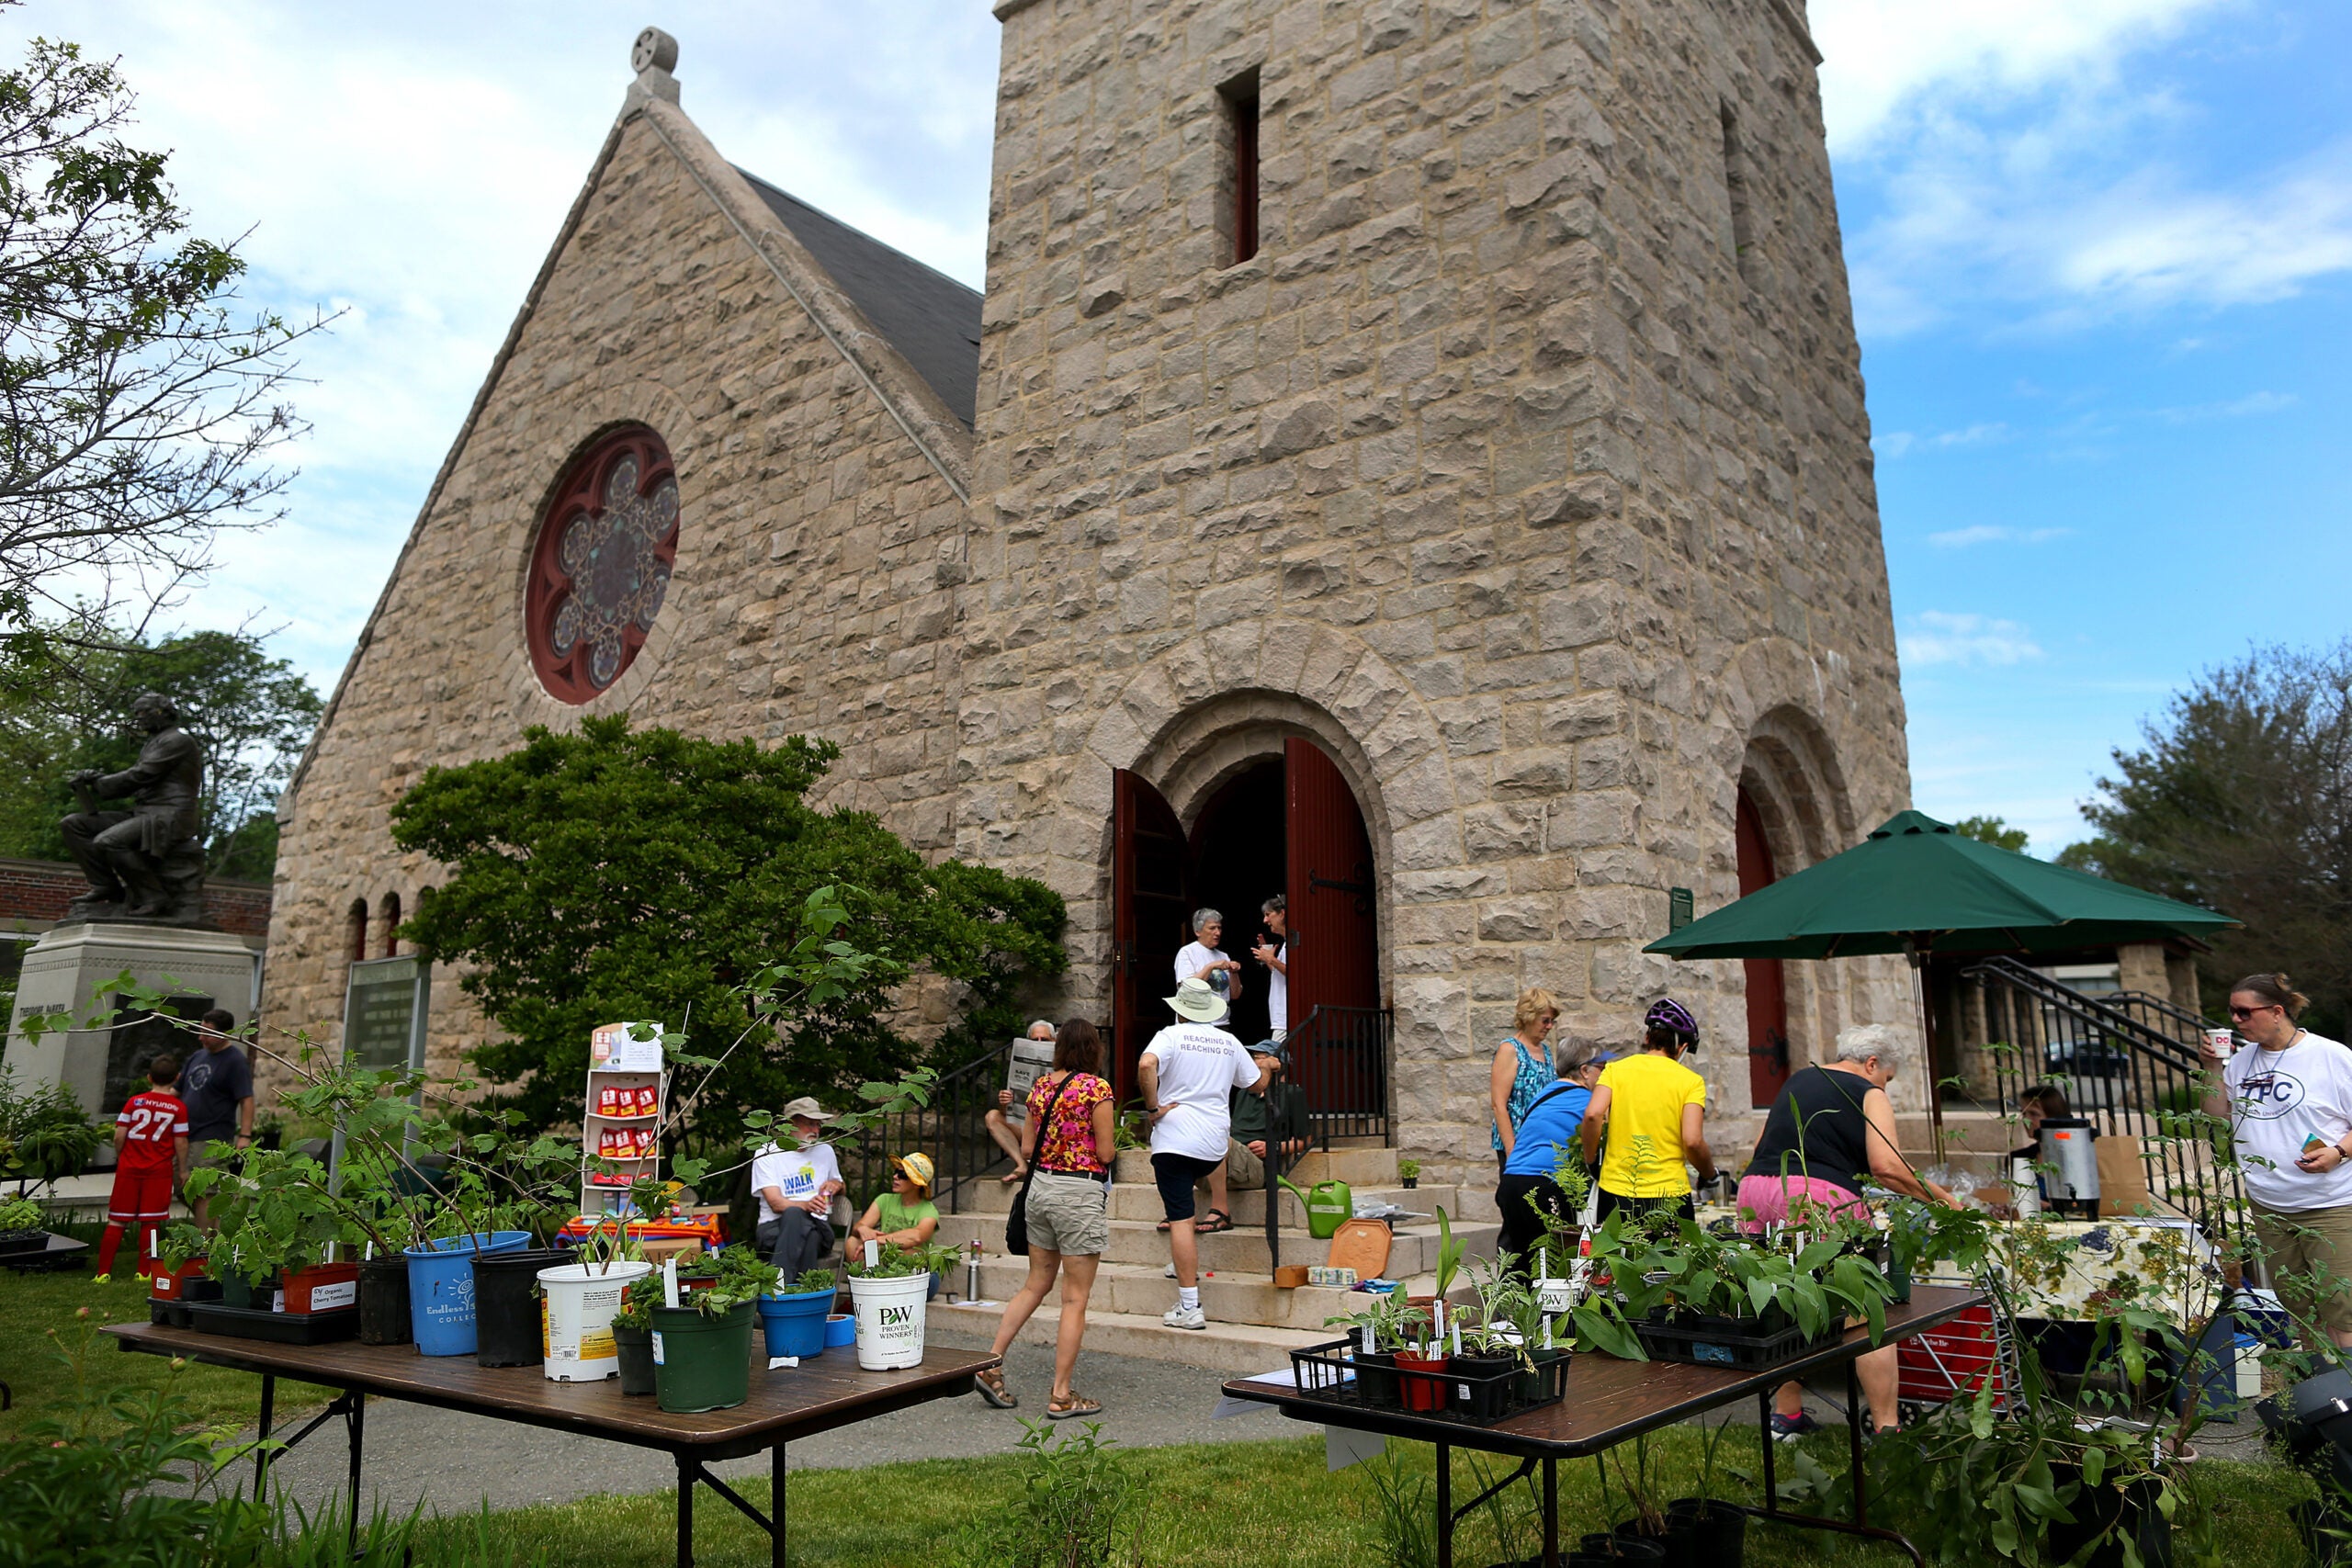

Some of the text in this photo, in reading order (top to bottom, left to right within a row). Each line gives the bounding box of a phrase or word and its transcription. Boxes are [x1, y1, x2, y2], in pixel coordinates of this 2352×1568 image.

[1183, 1035, 1225, 1044] REACHING
[1181, 1044, 1221, 1055] REACHING
[128, 1108, 175, 1142] 27
[784, 1173, 813, 1190] WALK
[426, 1304, 464, 1314] Endless
[882, 1324, 910, 1332] PROVEN
